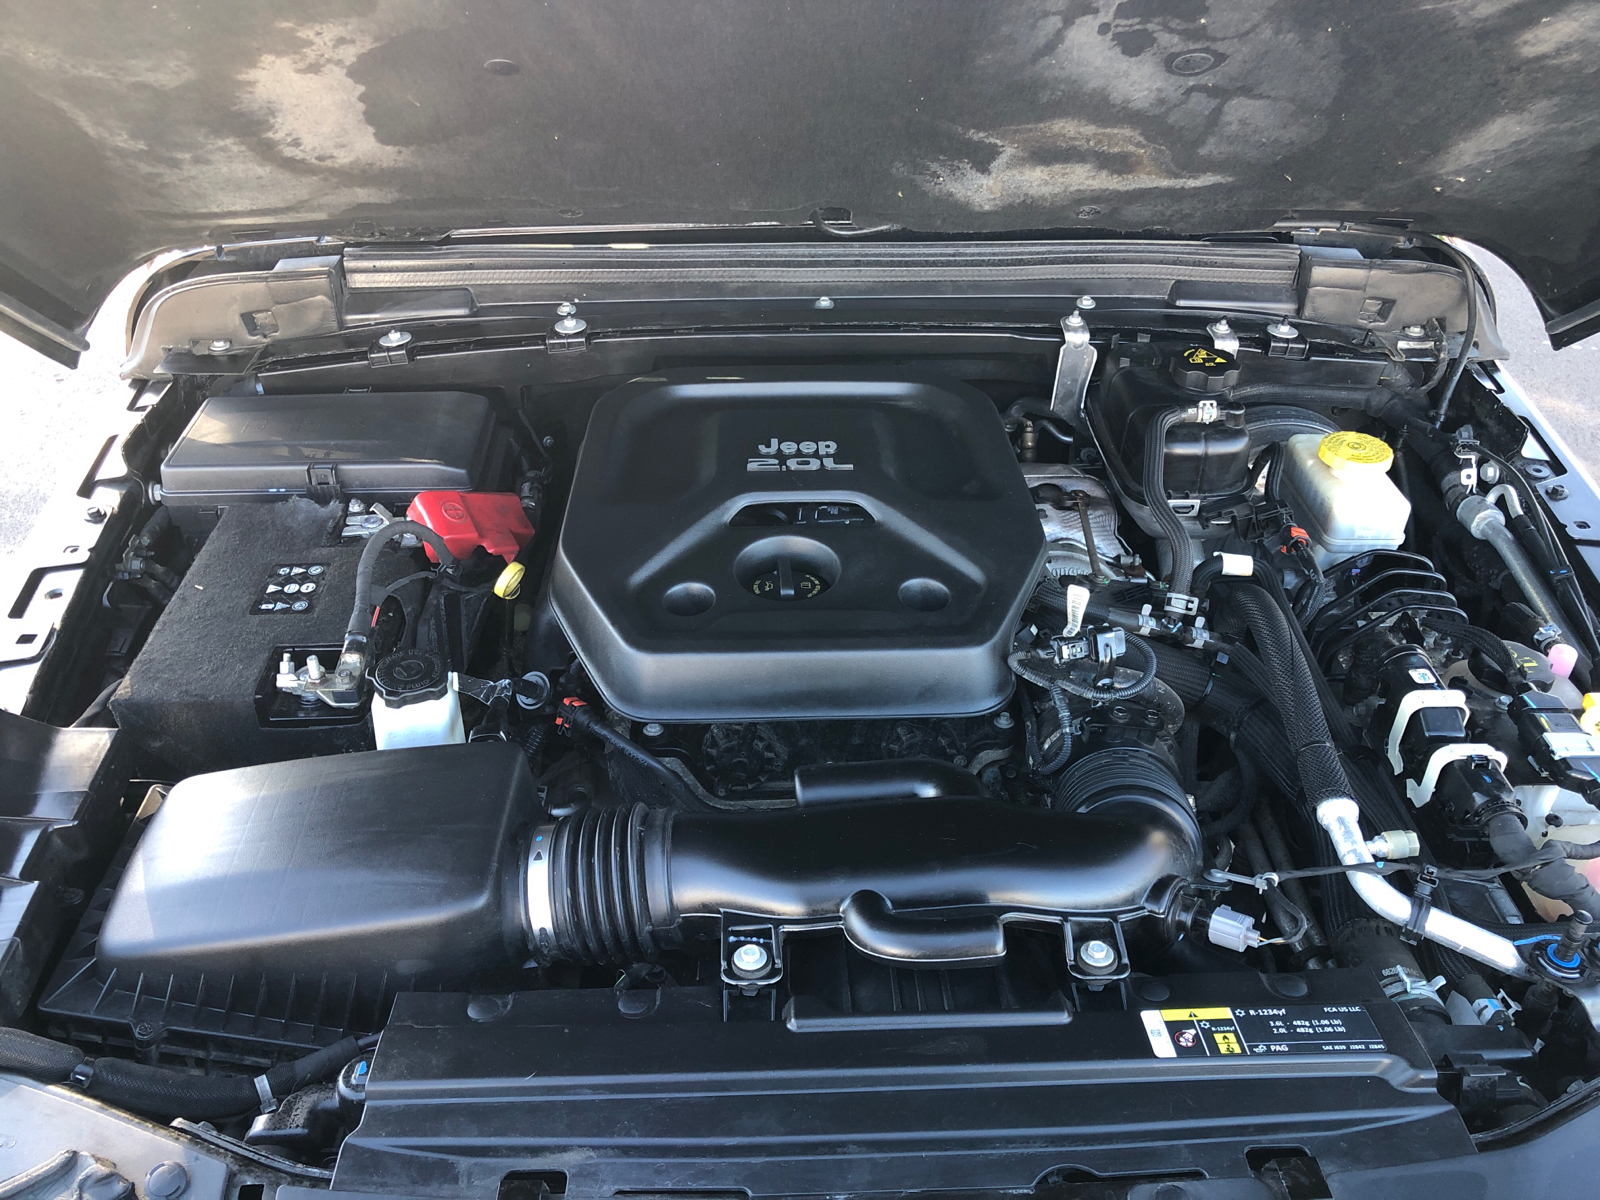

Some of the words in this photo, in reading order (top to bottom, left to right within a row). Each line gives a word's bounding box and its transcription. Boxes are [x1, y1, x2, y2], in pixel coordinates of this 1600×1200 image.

[758, 438, 838, 457] Jeep
[746, 457, 854, 472] 2.0L
[406, 679, 430, 690] FLUID
[1249, 1008, 1287, 1017] R-1234yf
[1270, 1044, 1289, 1052] PAG
